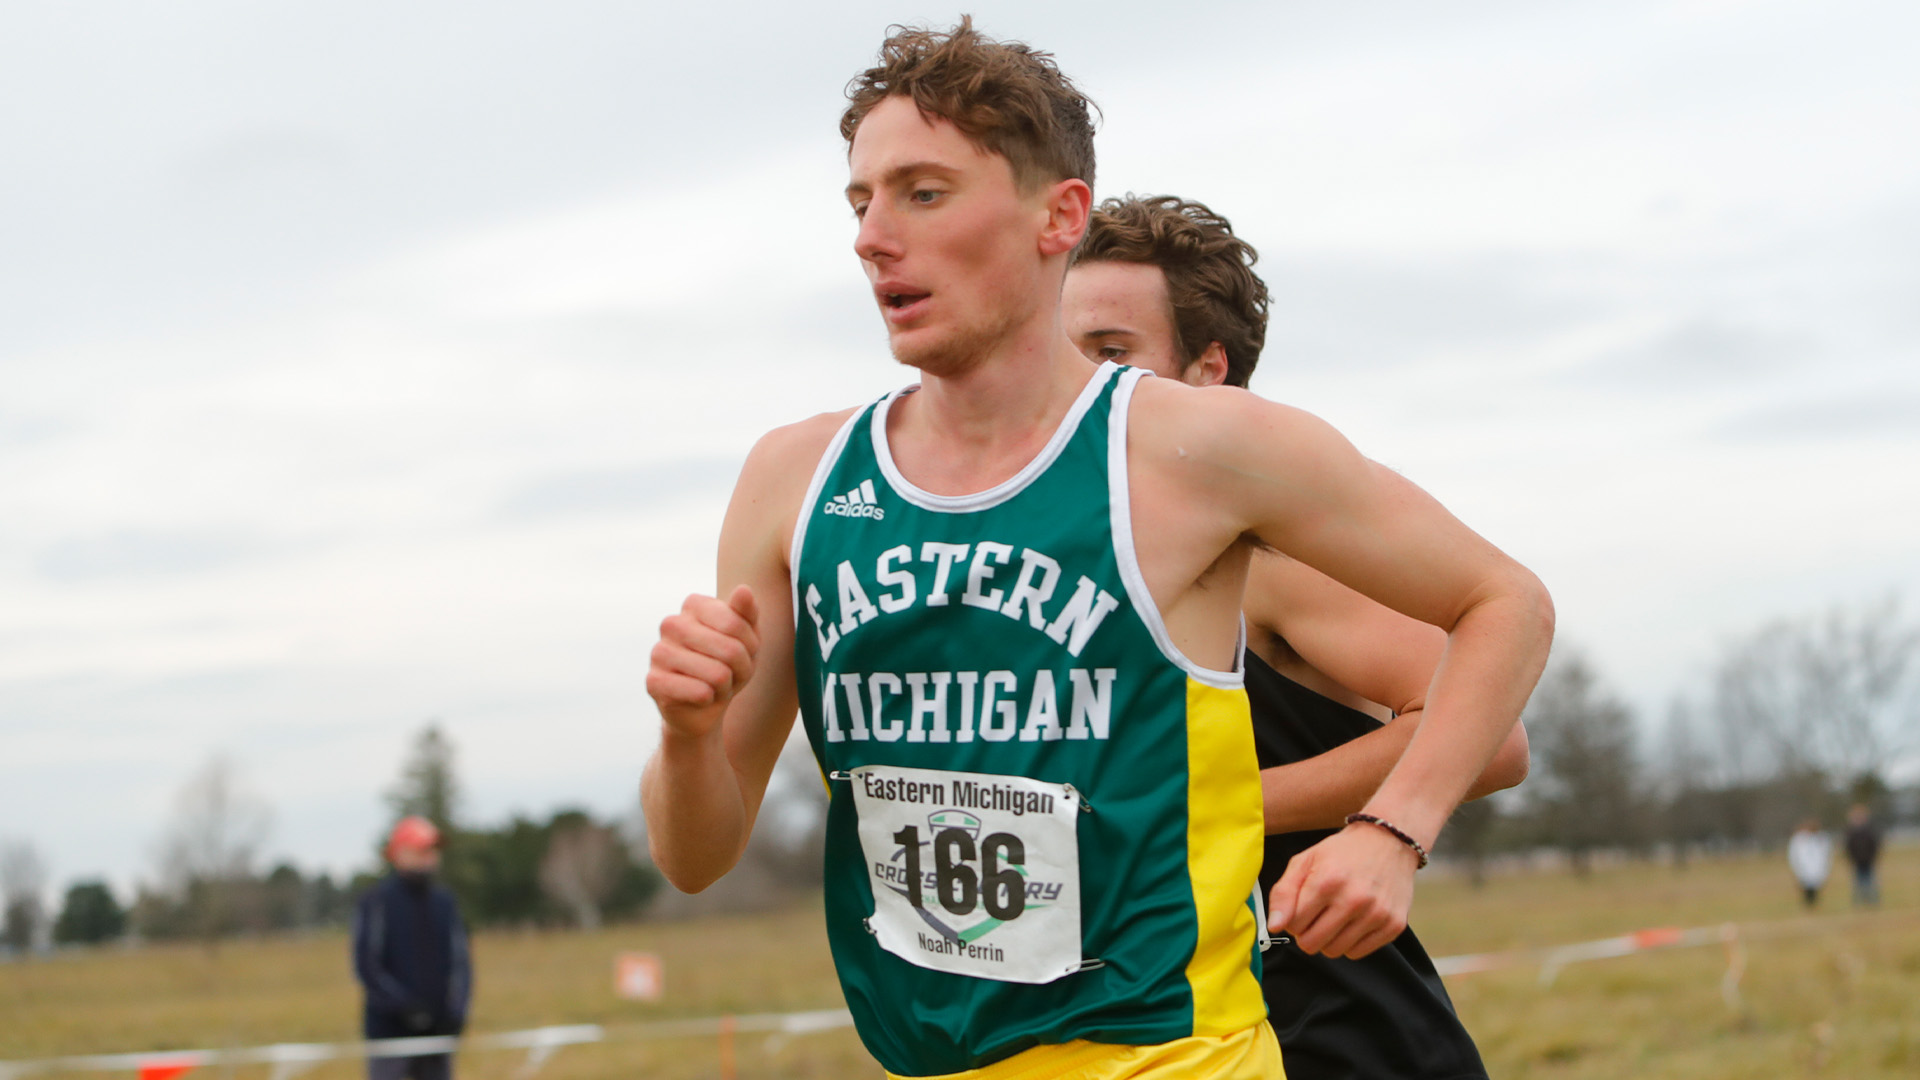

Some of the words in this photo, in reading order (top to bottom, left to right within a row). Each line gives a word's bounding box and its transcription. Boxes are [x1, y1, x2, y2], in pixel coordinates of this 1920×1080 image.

[824, 501, 884, 520] adidas
[805, 541, 1119, 663] EASTERN
[864, 772, 944, 805] Eastern
[952, 780, 1054, 816] Michigan
[893, 825, 1026, 921] 166
[917, 932, 953, 954] Noah
[958, 939, 1004, 962] Perrin
